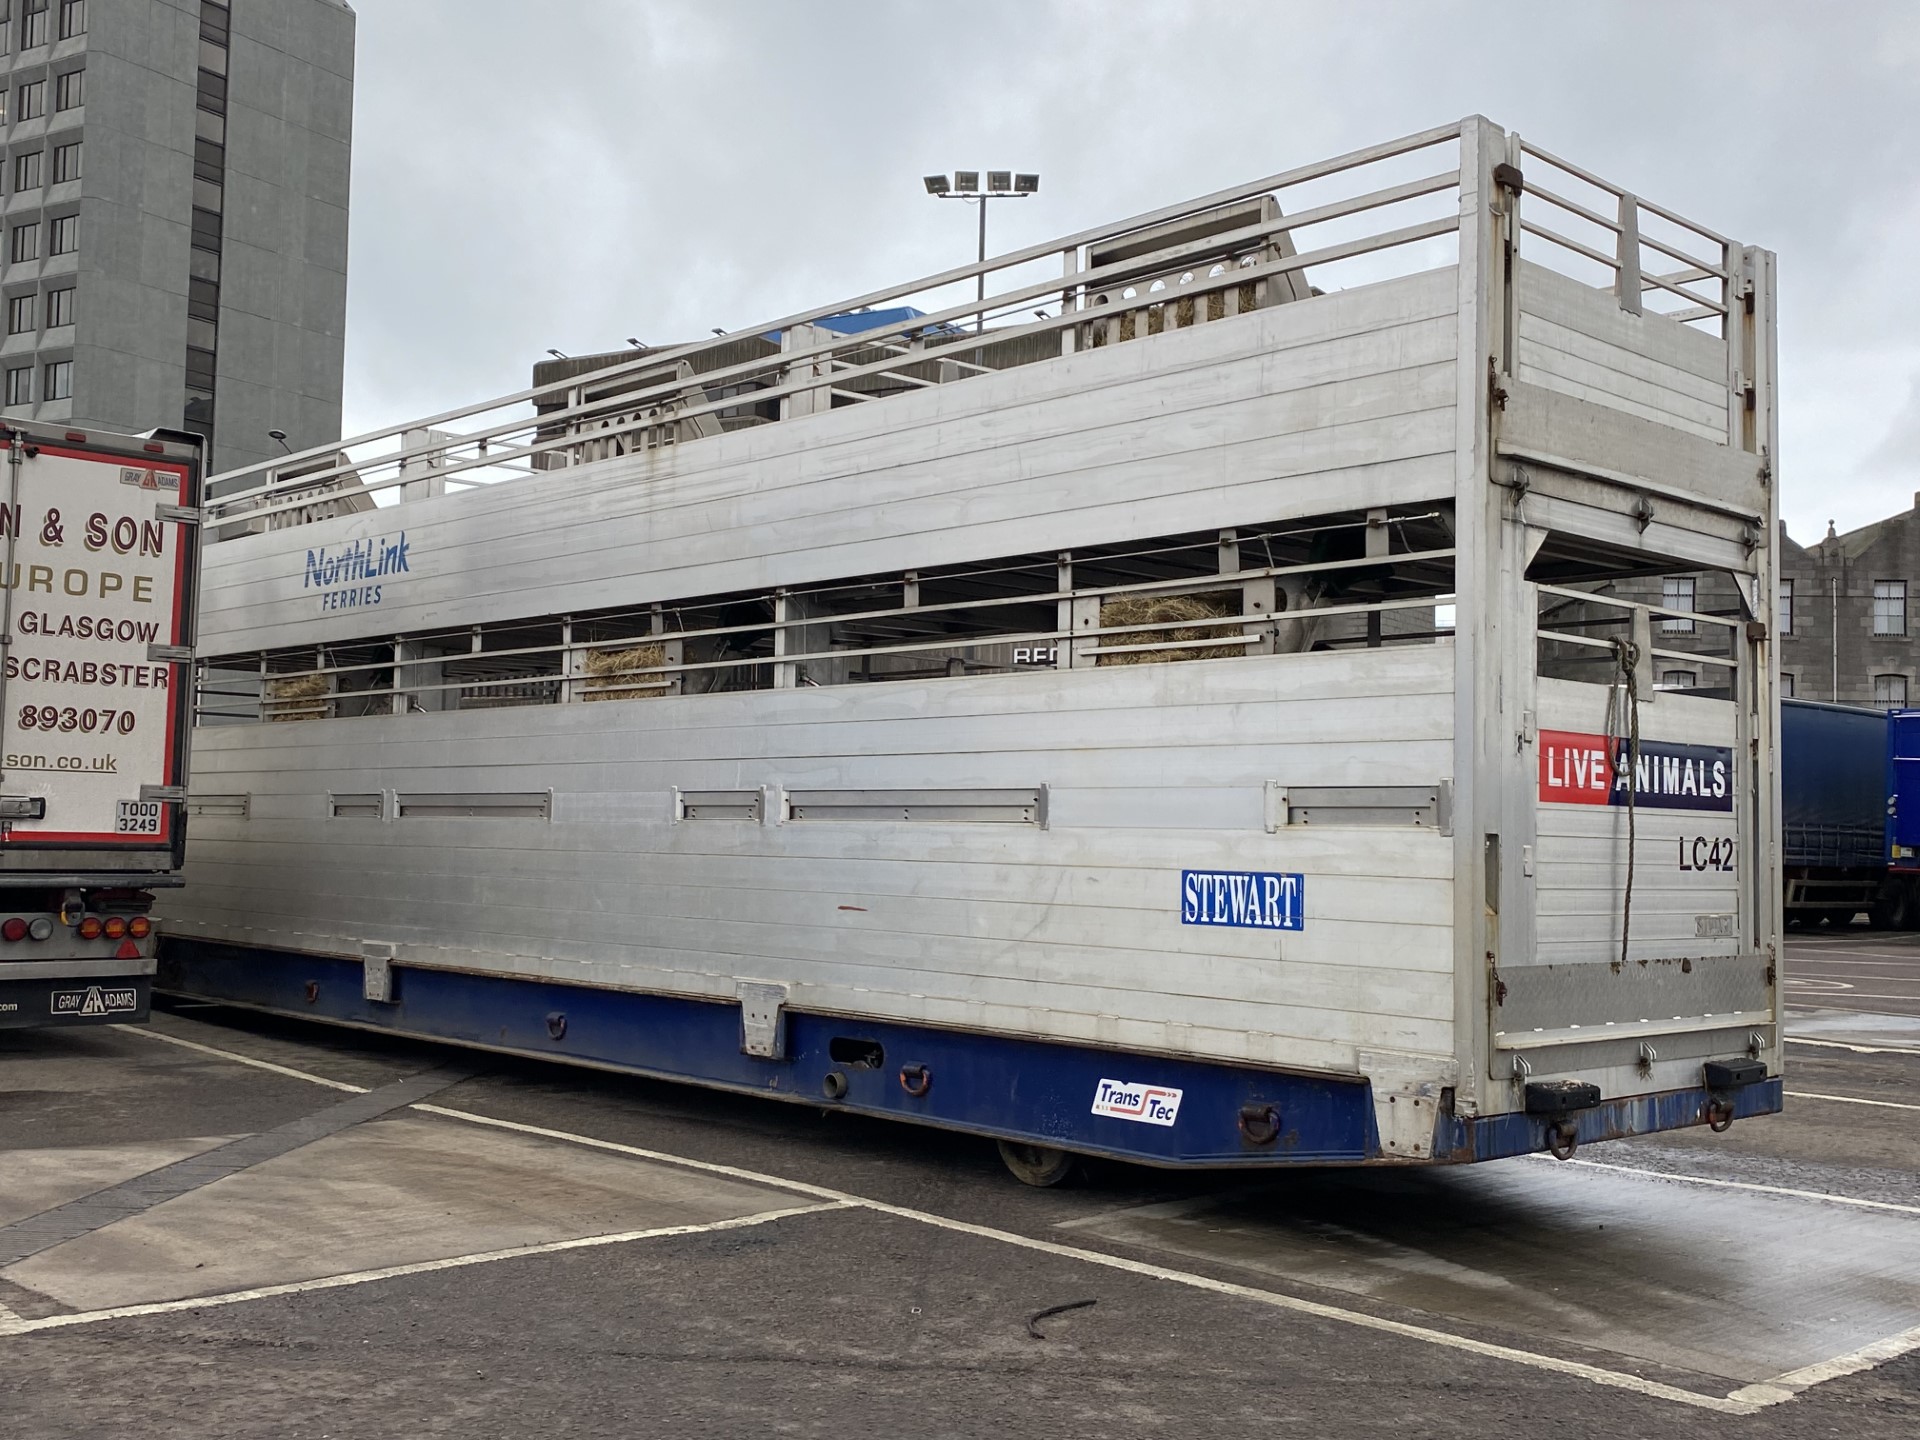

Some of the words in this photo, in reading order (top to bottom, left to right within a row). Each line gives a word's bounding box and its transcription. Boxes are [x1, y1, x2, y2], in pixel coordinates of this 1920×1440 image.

[123, 471, 142, 483] GRAY
[158, 476, 179, 488] ADAMS
[41, 507, 64, 545] &
[85, 512, 164, 556] SON
[304, 530, 410, 588] NorthLink
[322, 585, 382, 611] FERRIES
[19, 611, 160, 643] GLASGOW
[5, 656, 169, 688] SCRABSTER
[18, 705, 136, 734] 893070
[1548, 747, 1606, 790] LIVE
[1615, 752, 1726, 798] ANIMALS
[119, 818, 157, 832] 3249
[1679, 836, 1734, 871] LC42
[1185, 872, 1297, 927] STEWART
[58, 994, 82, 1009] GRAY
[104, 992, 134, 1007] ADAMS
[1101, 1083, 1140, 1107] Trans
[1149, 1099, 1174, 1120] Tec
